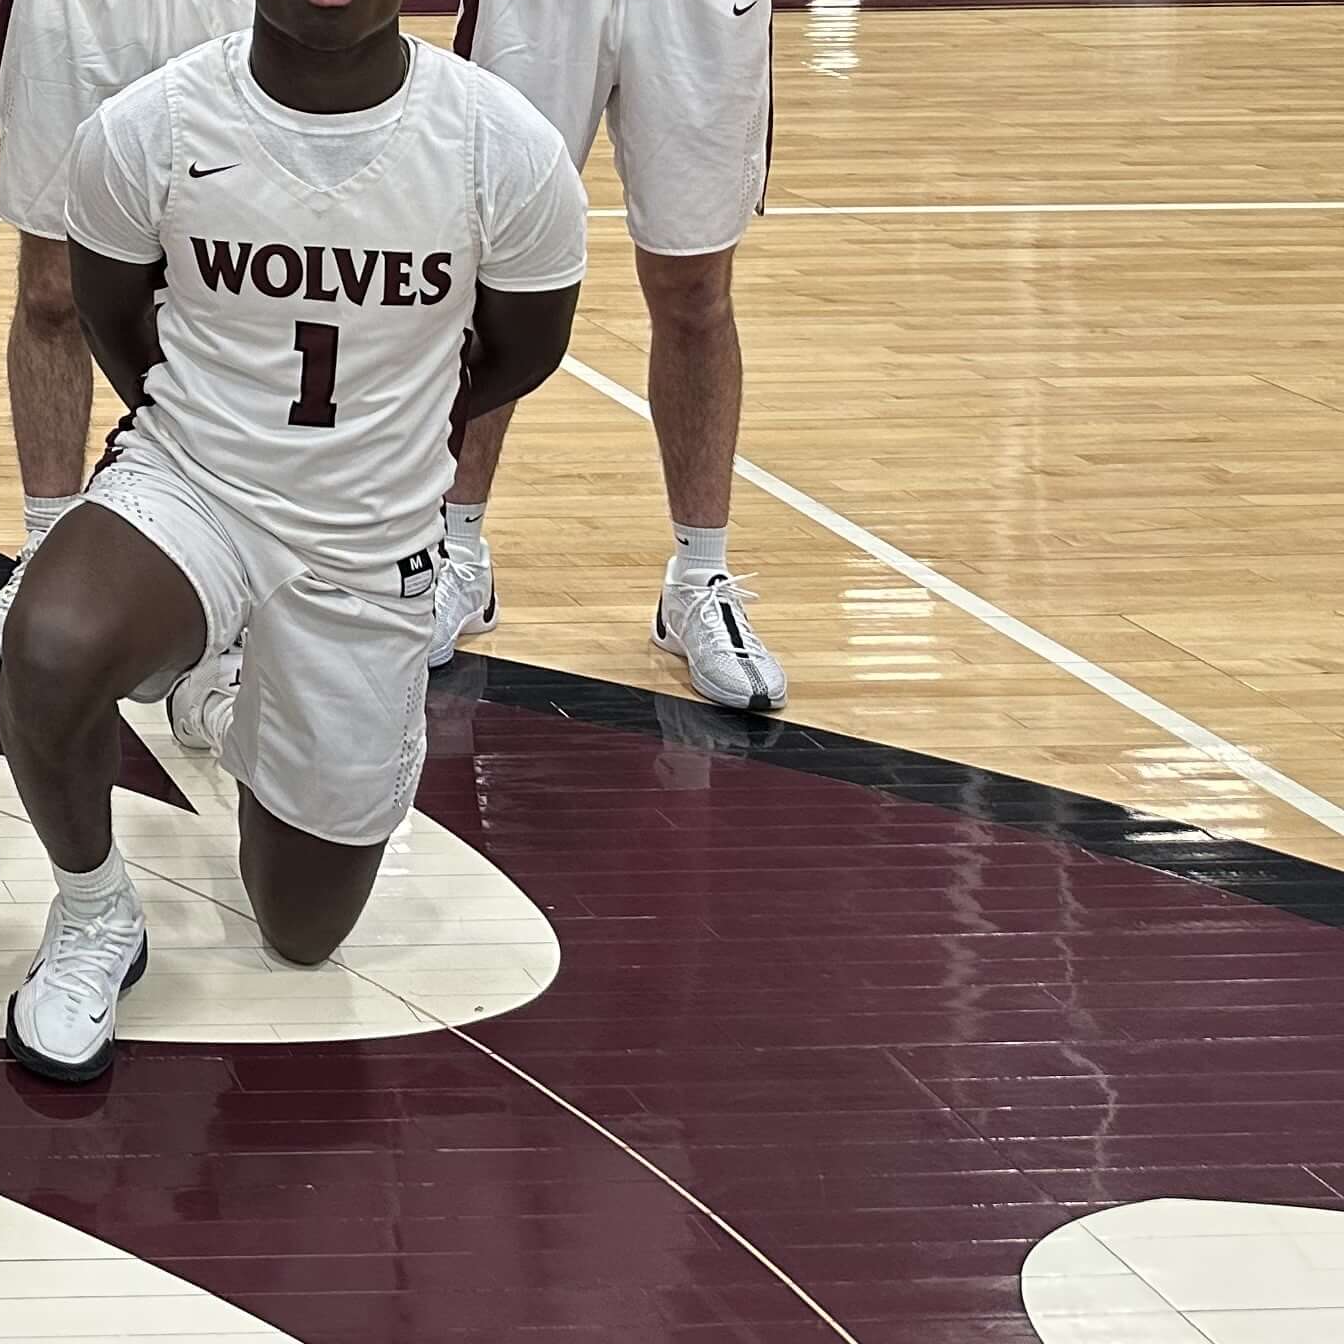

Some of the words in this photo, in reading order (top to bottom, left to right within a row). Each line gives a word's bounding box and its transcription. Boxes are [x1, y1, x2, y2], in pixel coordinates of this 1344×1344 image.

[189, 236, 452, 307] WOLVES
[287, 319, 340, 429] 1
[409, 554, 423, 571] M
